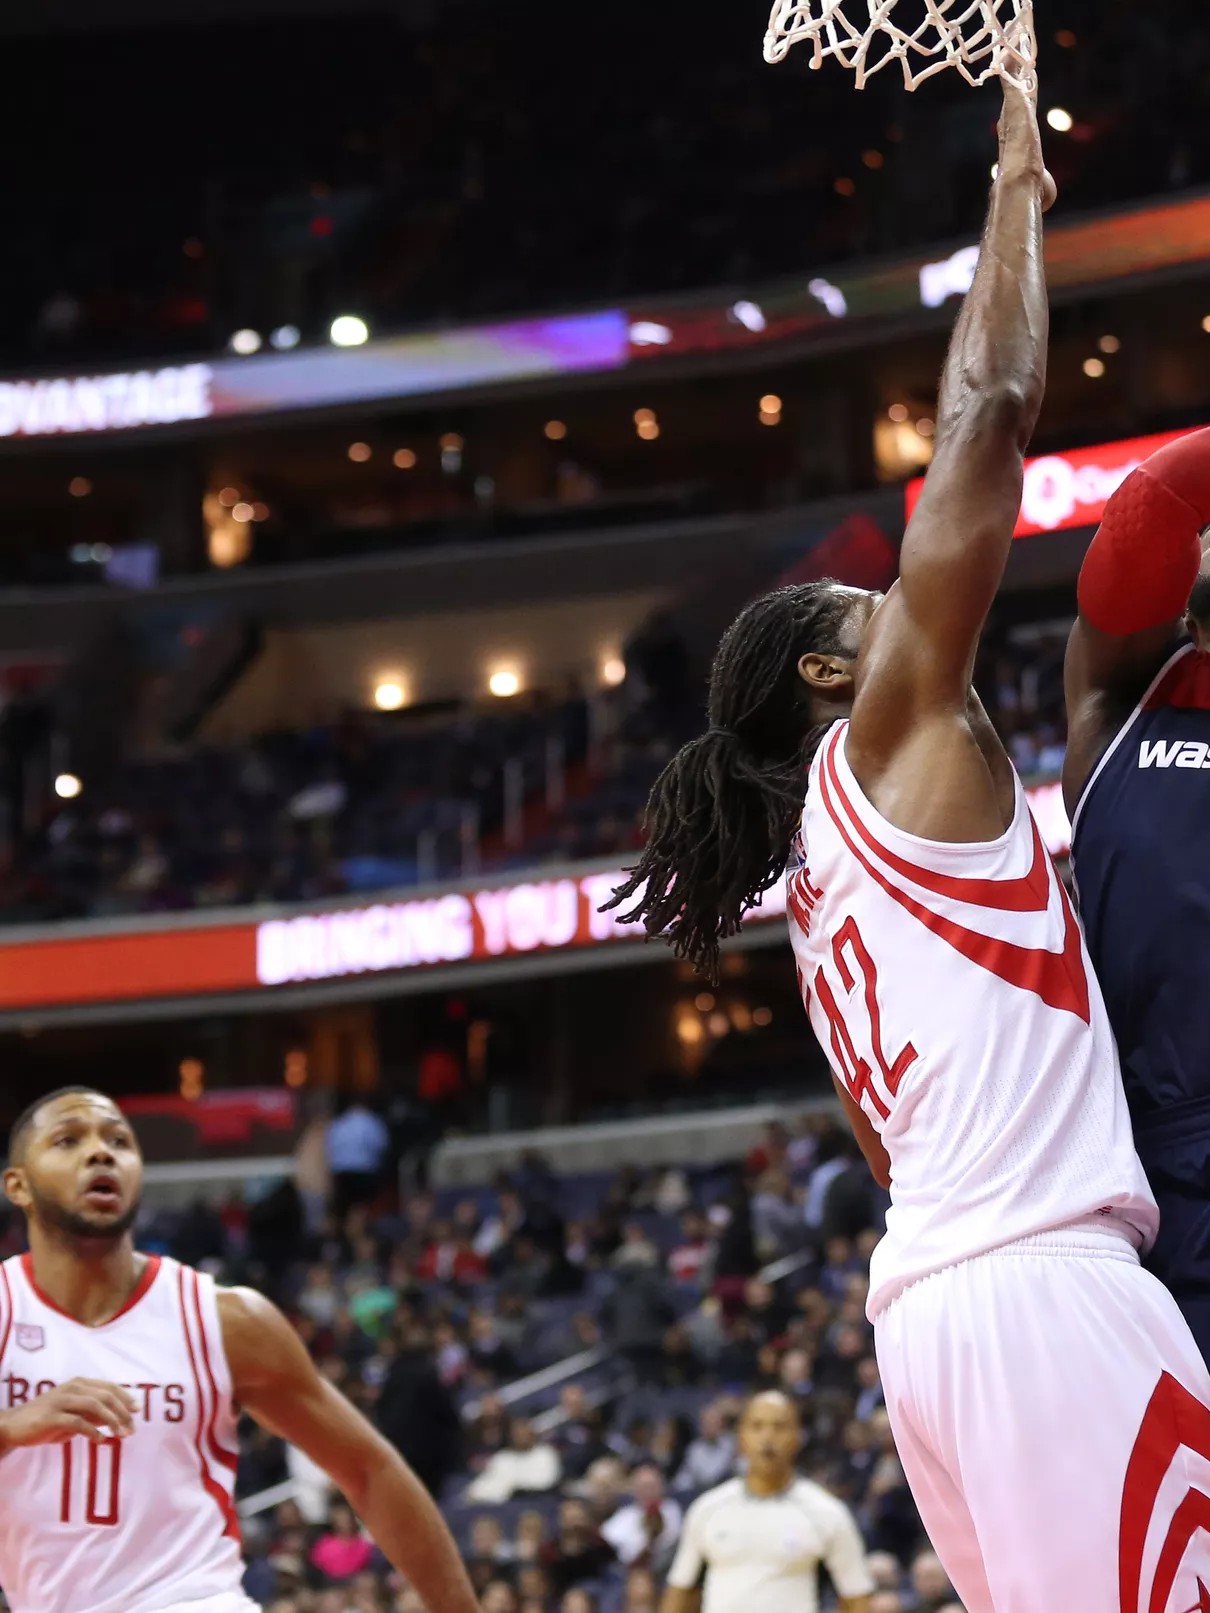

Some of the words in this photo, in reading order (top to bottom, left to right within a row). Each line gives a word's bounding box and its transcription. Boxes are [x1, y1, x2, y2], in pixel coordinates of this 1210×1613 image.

[256, 894, 474, 986] BRINGING
[474, 878, 580, 956] YOU
[814, 914, 920, 1122] 42
[60, 1436, 122, 1526] 10
